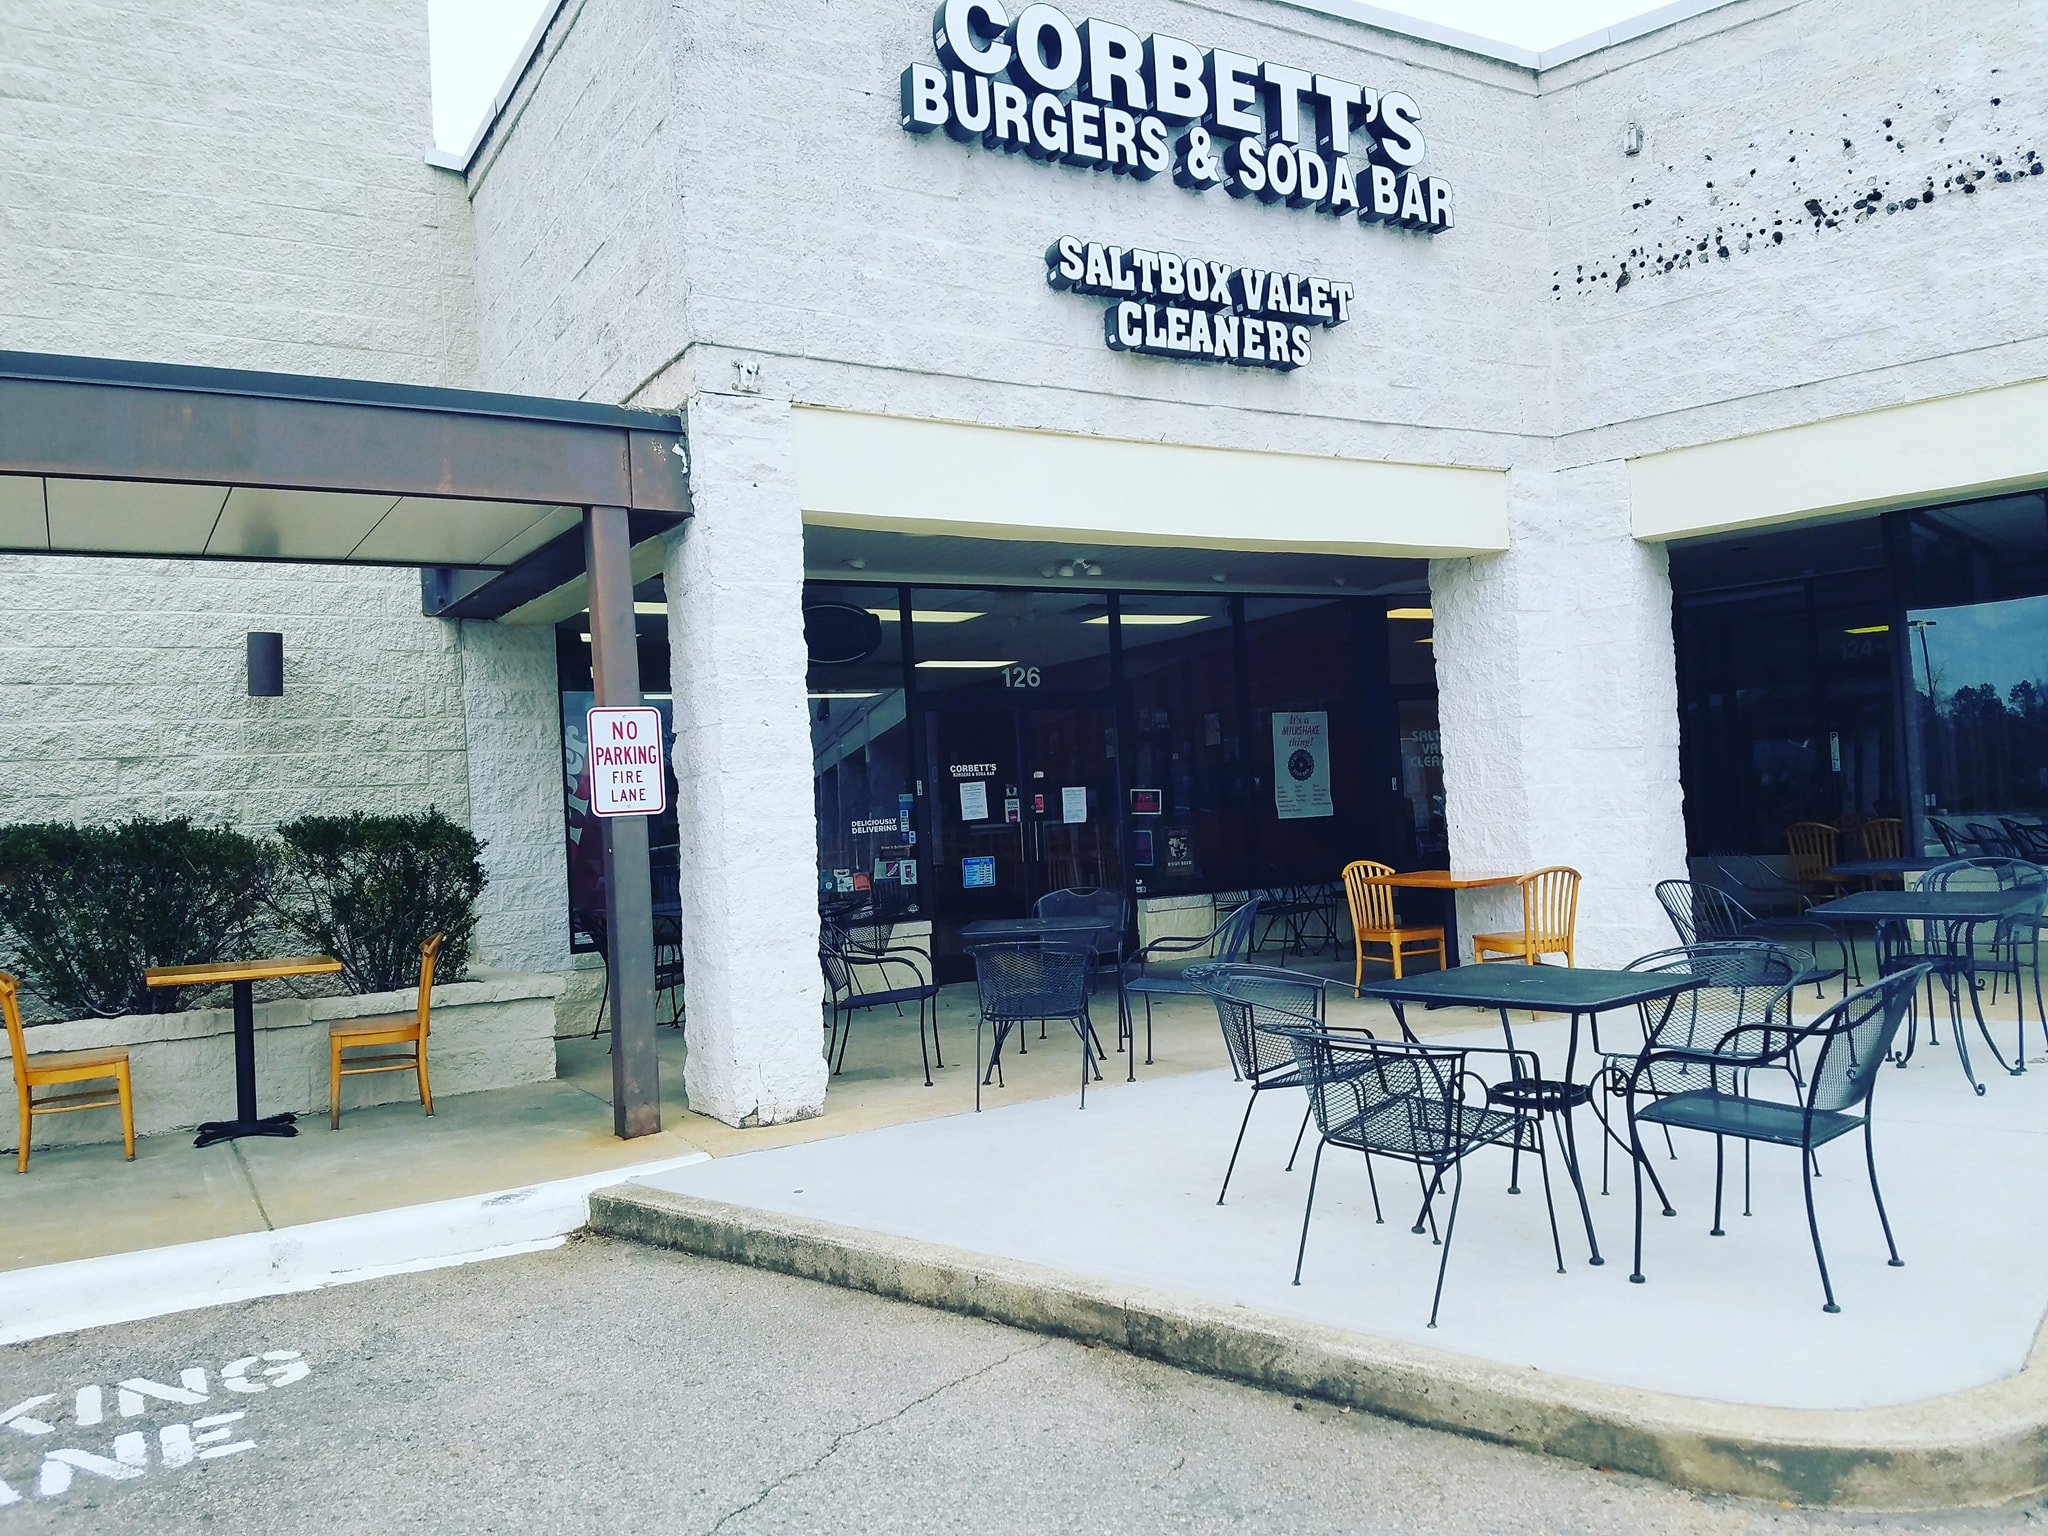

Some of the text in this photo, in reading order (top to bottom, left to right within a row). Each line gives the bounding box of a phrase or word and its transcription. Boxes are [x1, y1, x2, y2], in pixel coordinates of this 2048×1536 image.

[938, 0, 1426, 169] CORBETT'S
[906, 63, 1455, 229] BURGERS & SODA BAR
[1056, 236, 1354, 322] SALTBOX VALET
[1115, 302, 1312, 367] CLEANERS
[1001, 666, 1041, 688] 126
[611, 720, 638, 741] NO
[1281, 725, 1320, 736] MILKSHAKE
[1288, 736, 1314, 749] thing!
[595, 745, 657, 766] PARKING
[612, 770, 644, 784] FIRE
[949, 763, 997, 773] CORBETT'S
[611, 788, 646, 803] LANE
[851, 817, 897, 828] DELICIOUSLY
[851, 824, 898, 835] DELIVERING
[0, 1411, 257, 1506] NE
